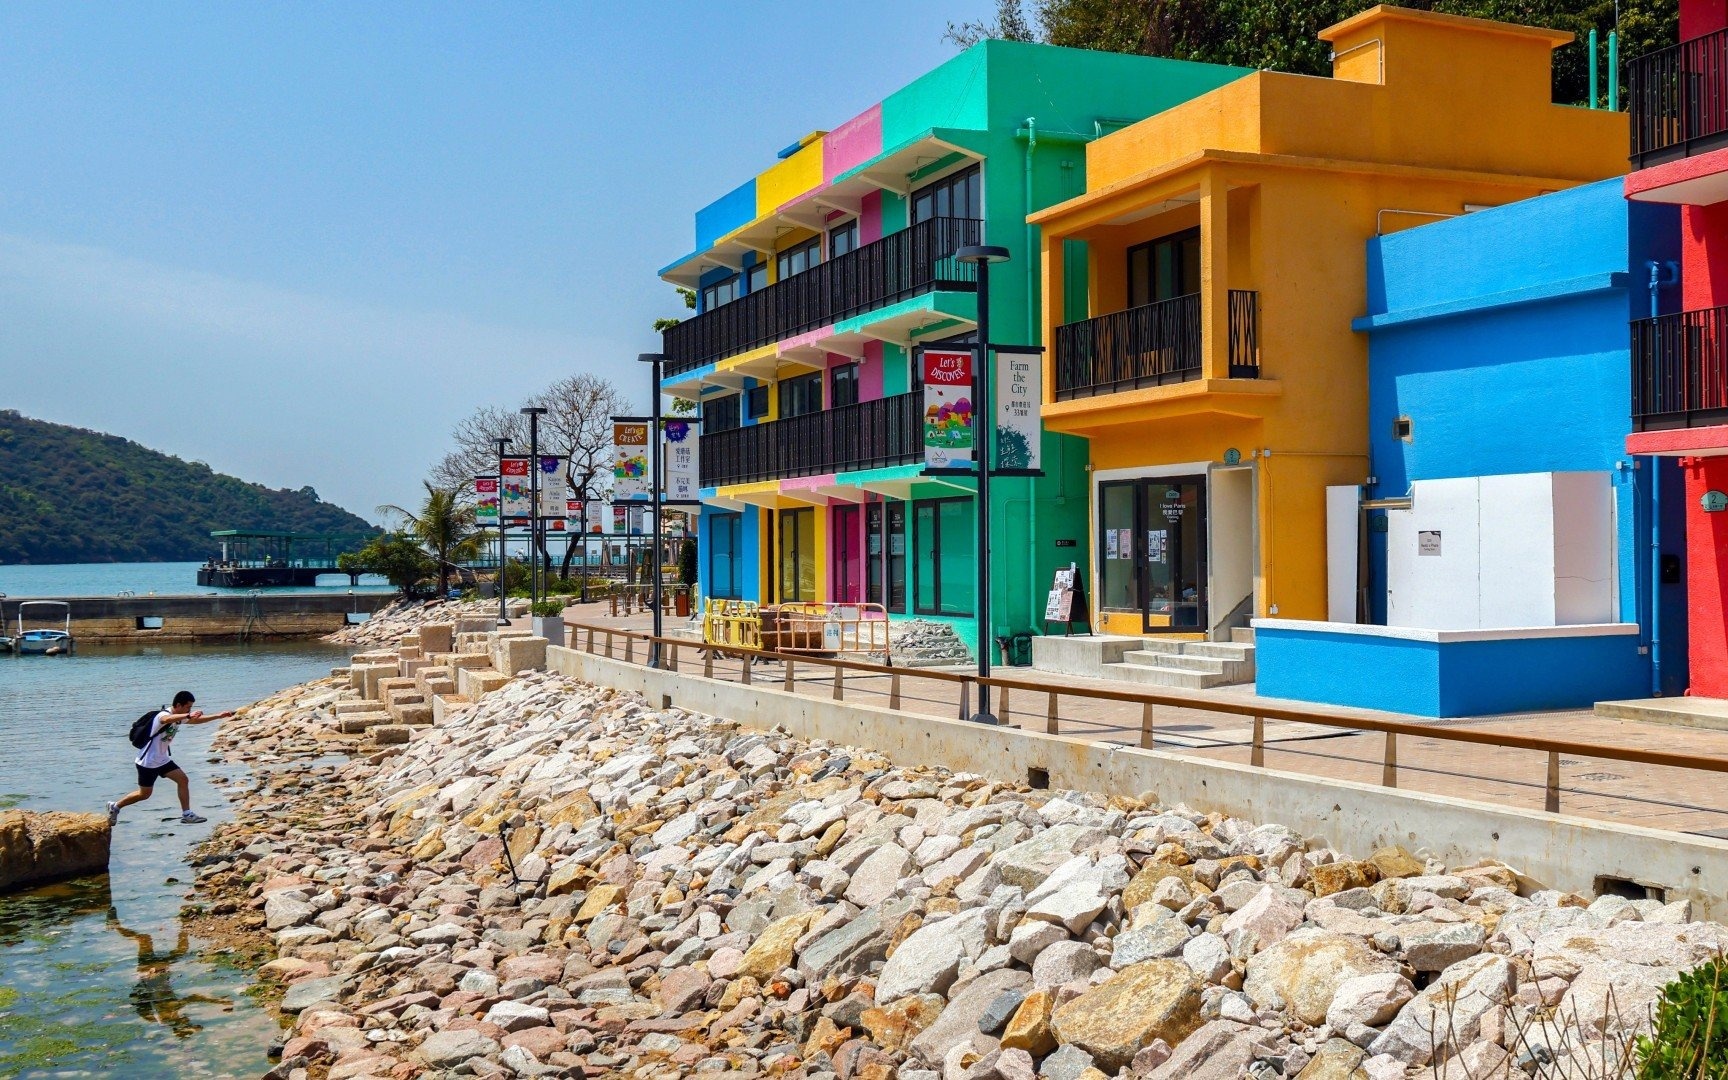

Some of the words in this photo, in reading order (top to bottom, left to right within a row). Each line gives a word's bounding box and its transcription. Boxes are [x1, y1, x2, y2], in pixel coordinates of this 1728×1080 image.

[939, 357, 956, 368] Let's
[1010, 360, 1029, 371] Farm
[930, 367, 965, 382] DISCOVER
[1013, 371, 1026, 383] the
[1011, 383, 1028, 397] City
[624, 426, 636, 434] Let's
[618, 433, 643, 443] CREATE
[1711, 494, 1717, 504] 2
